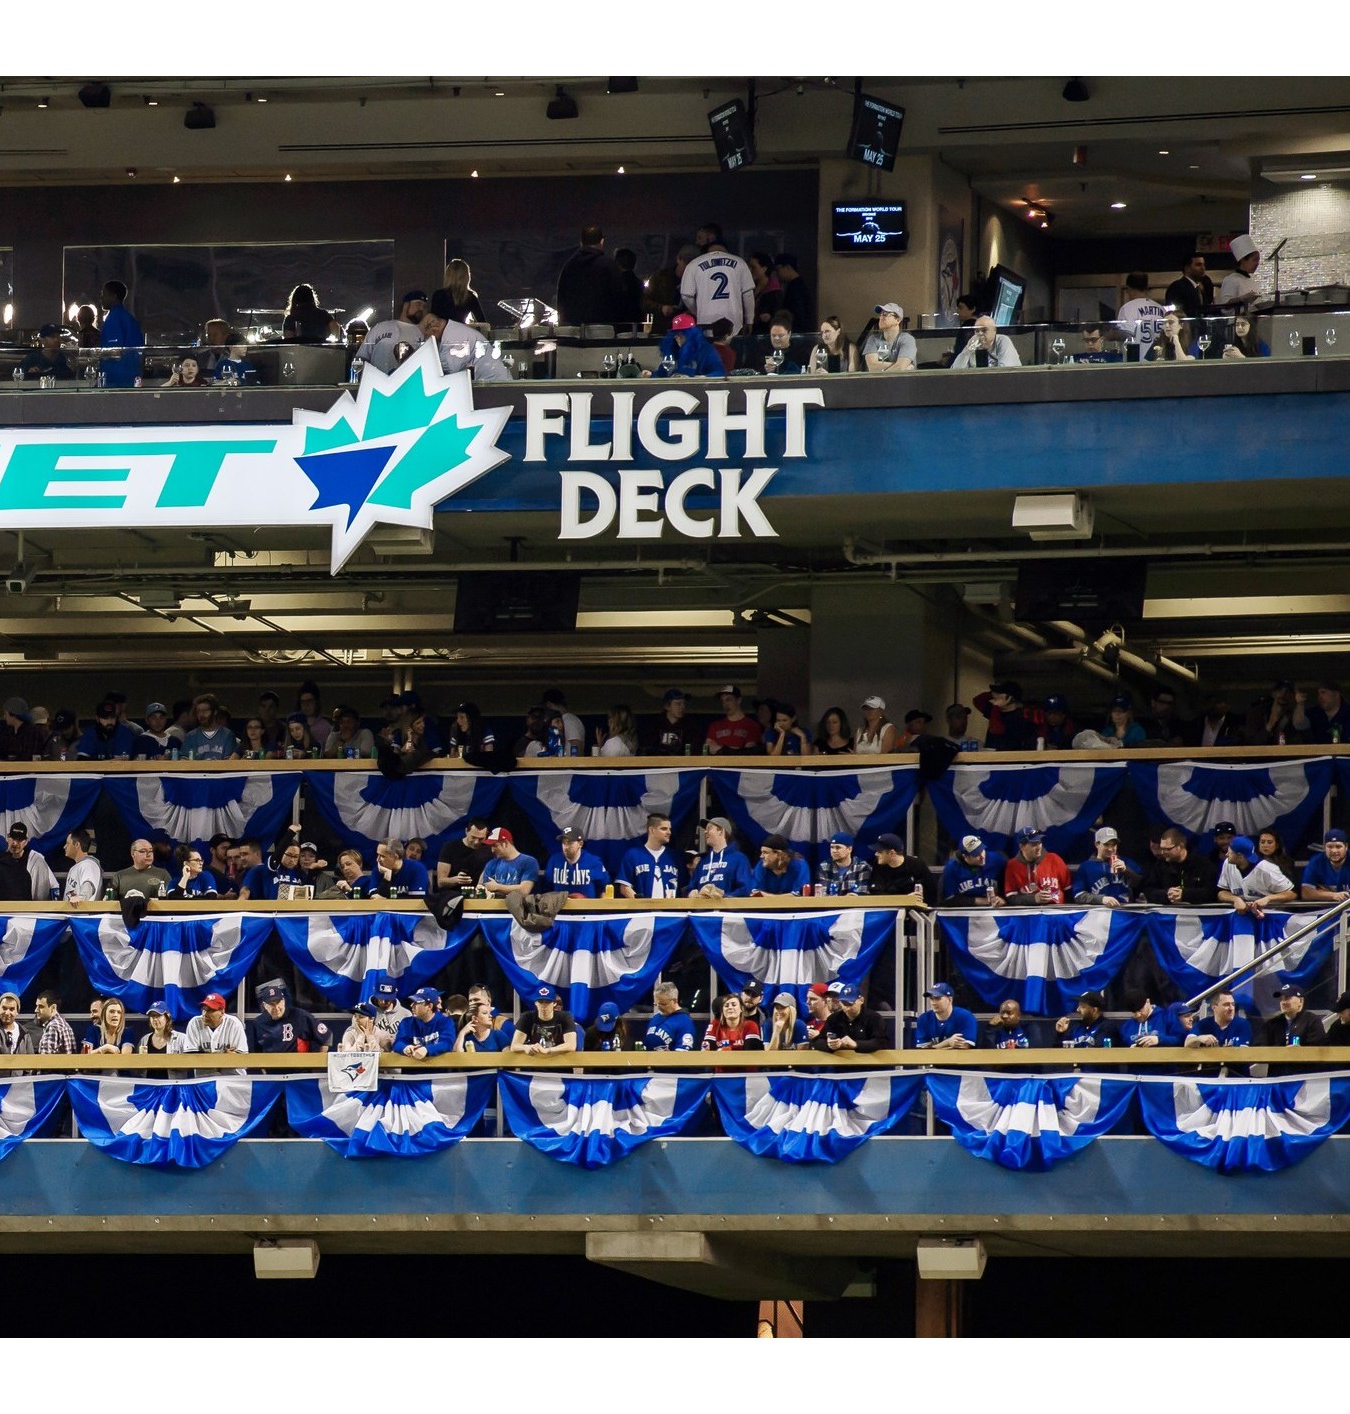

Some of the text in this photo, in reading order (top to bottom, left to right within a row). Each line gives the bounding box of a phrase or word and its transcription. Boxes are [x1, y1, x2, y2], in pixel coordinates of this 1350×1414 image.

[863, 149, 884, 166] MAY 25
[710, 272, 730, 300] 2
[1138, 306, 1164, 317] MARTIN
[523, 388, 825, 461] FLIGHT
[558, 468, 780, 539] DECK
[571, 868, 591, 885] JAYS
[959, 879, 975, 893] LUE
[282, 1023, 294, 1042] B
[655, 1027, 673, 1045] JAYS
